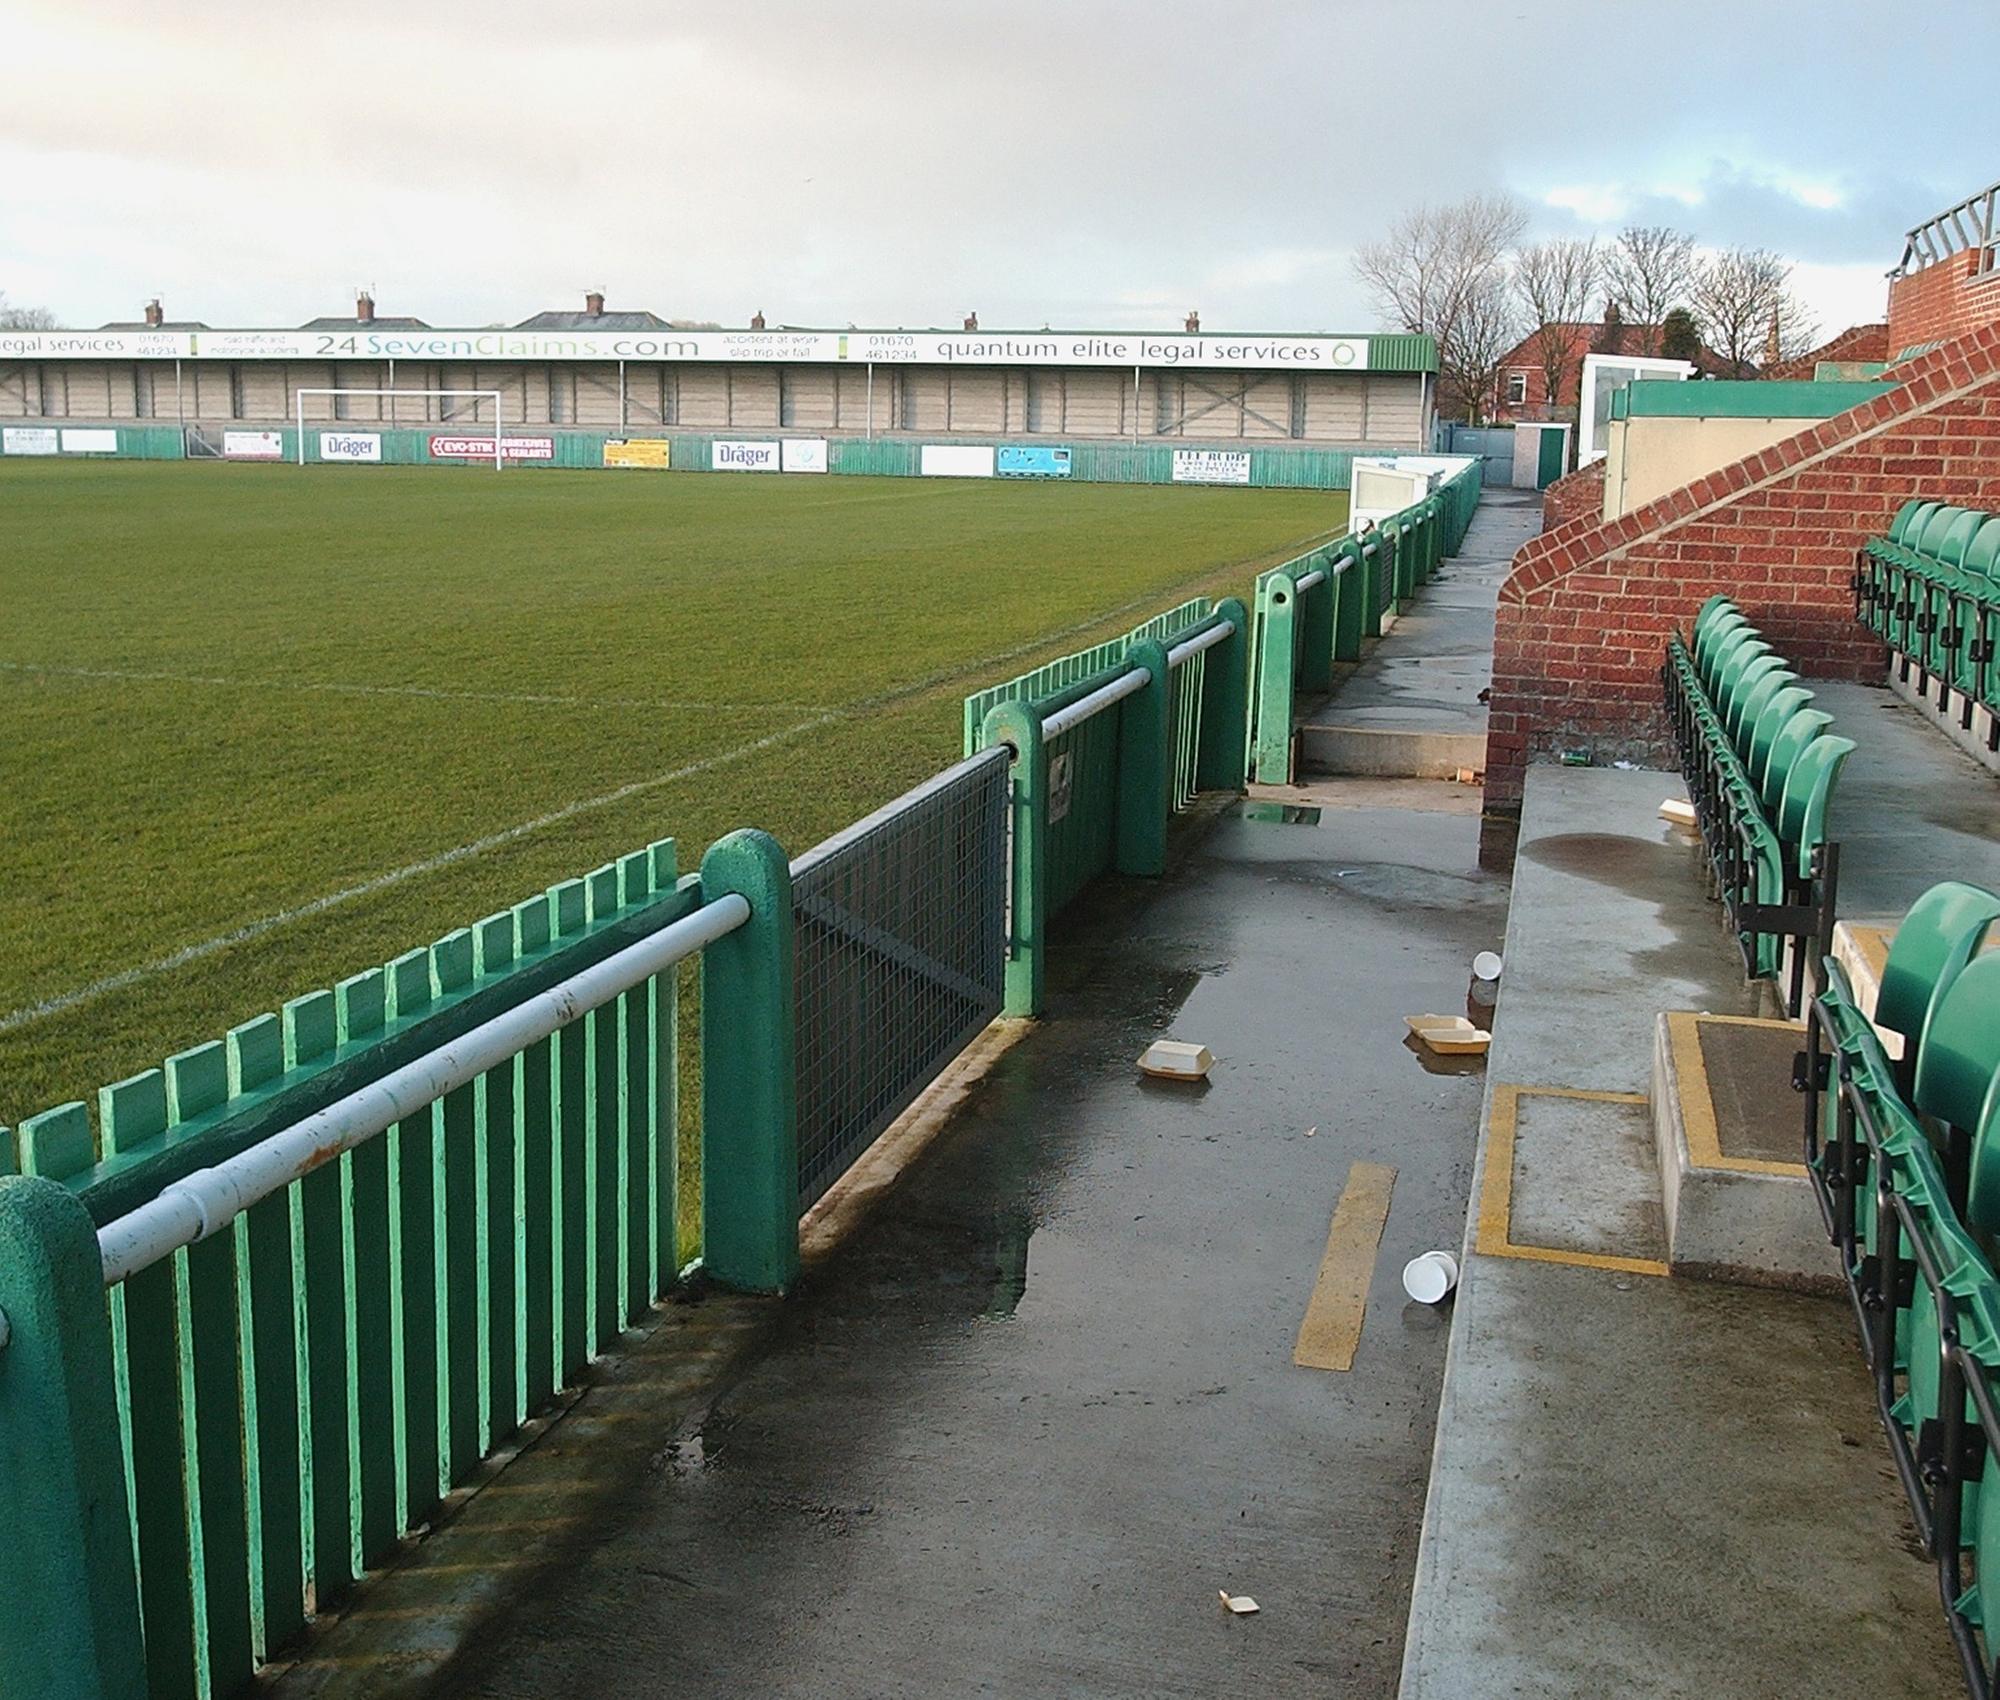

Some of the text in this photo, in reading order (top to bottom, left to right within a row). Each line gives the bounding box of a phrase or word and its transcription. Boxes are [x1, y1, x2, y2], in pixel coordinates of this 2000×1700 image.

[0, 336, 125, 356] egal services
[868, 336, 915, 346] 01670
[865, 350, 918, 360] 461234
[937, 339, 1321, 365] quantum elite legal services
[720, 444, 771, 467] Dräger
